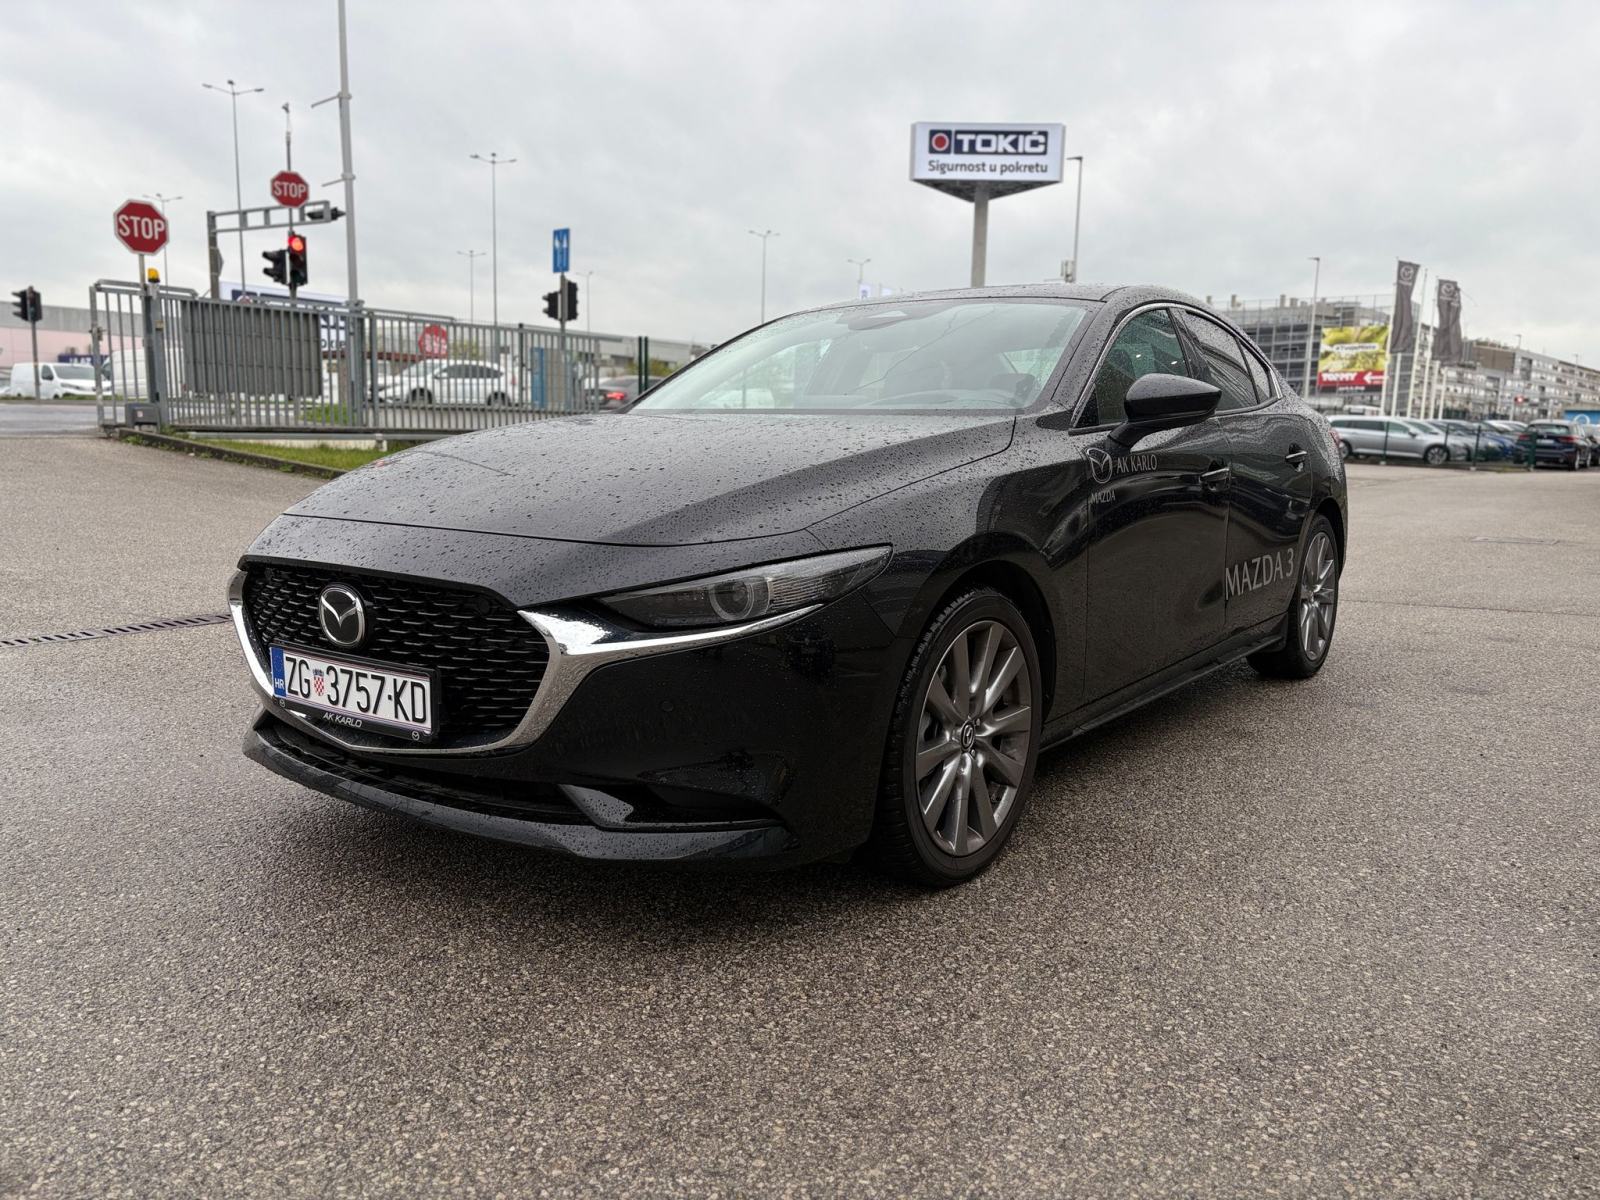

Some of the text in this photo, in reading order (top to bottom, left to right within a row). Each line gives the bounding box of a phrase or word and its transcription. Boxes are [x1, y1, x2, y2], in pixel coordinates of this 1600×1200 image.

[956, 131, 1046, 153] TOKIĆ
[928, 160, 1048, 175] Sigurnost u pokretu
[274, 181, 306, 199] STOP
[118, 214, 165, 241] STOP
[1117, 454, 1158, 473] AK KARLO
[1225, 548, 1295, 600] MAZDA 3
[274, 677, 286, 690] HR
[285, 655, 312, 699] ZG
[323, 711, 363, 728] AK KARLO
